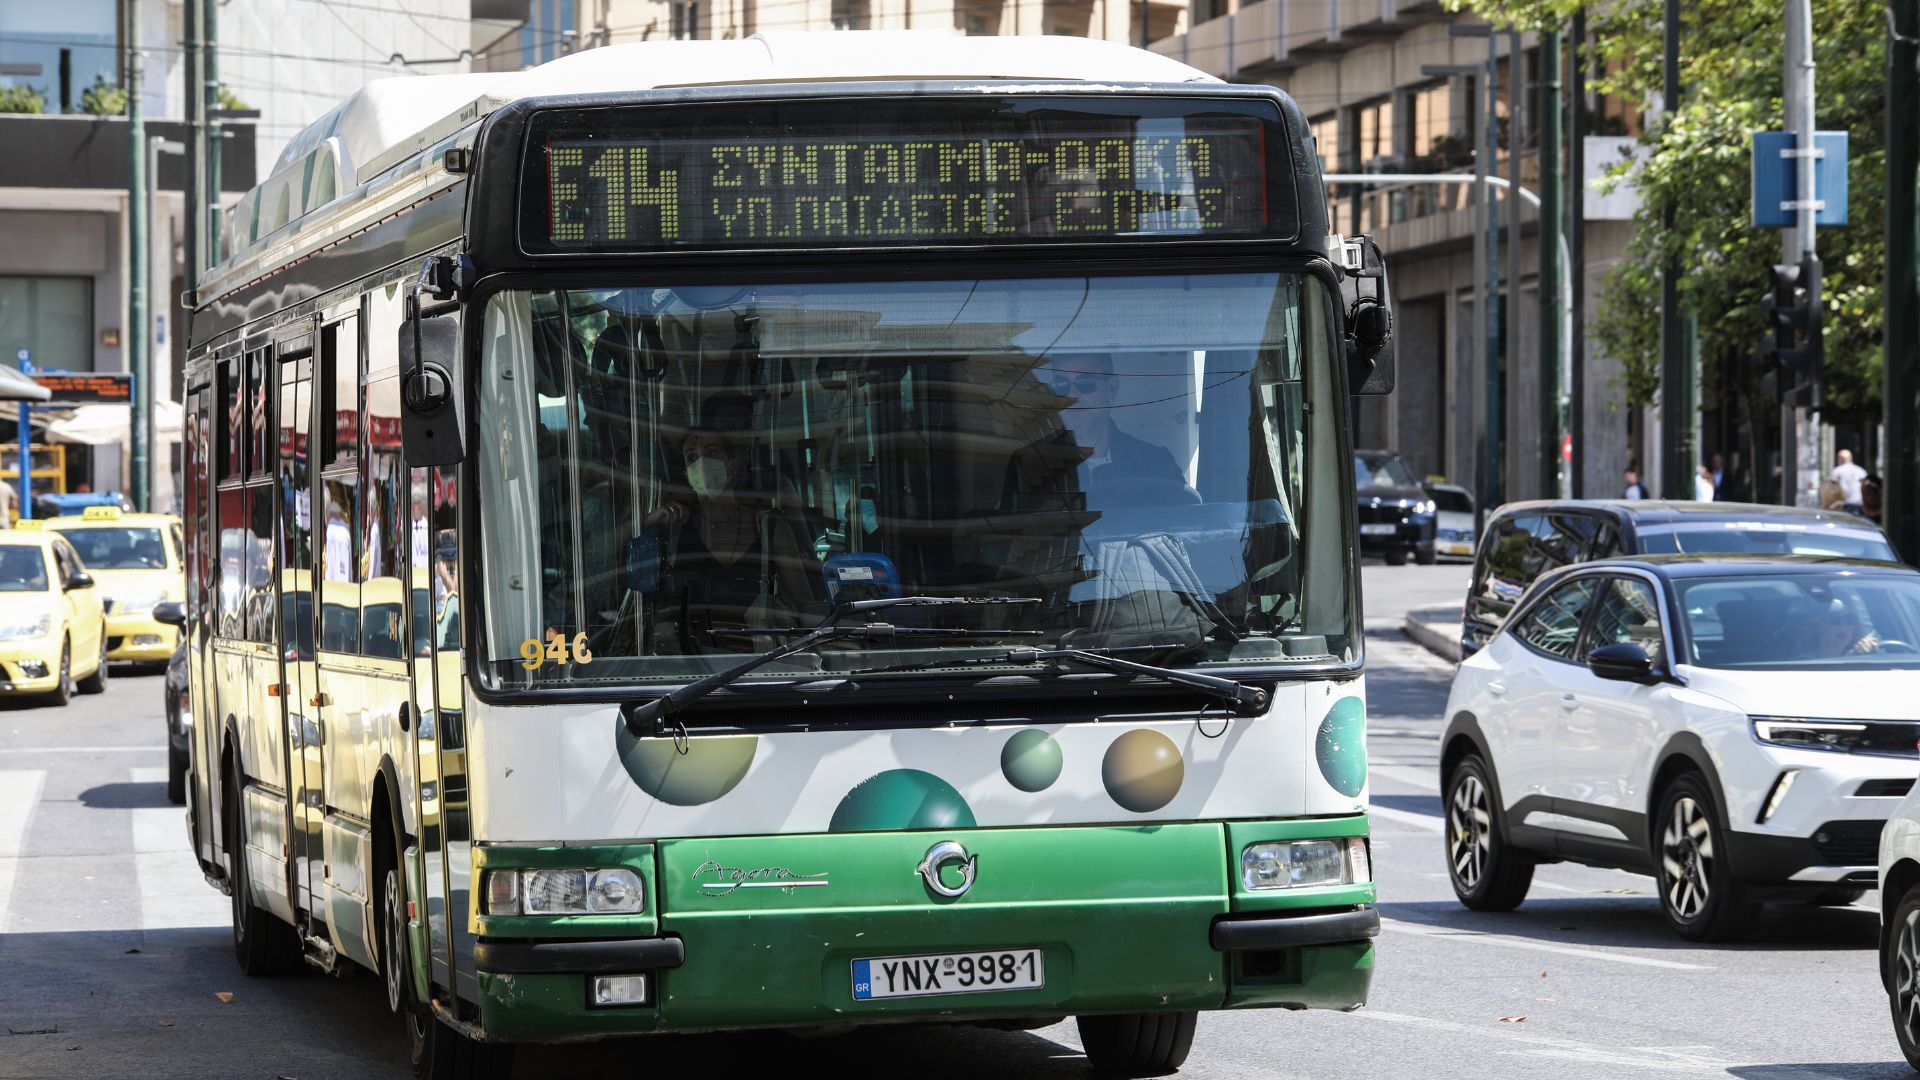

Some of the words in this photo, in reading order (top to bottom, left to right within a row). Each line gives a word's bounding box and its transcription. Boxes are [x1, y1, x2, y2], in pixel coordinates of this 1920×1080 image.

[520, 631, 593, 671] 946
[691, 860, 829, 898] Agora
[855, 983, 869, 992] GR
